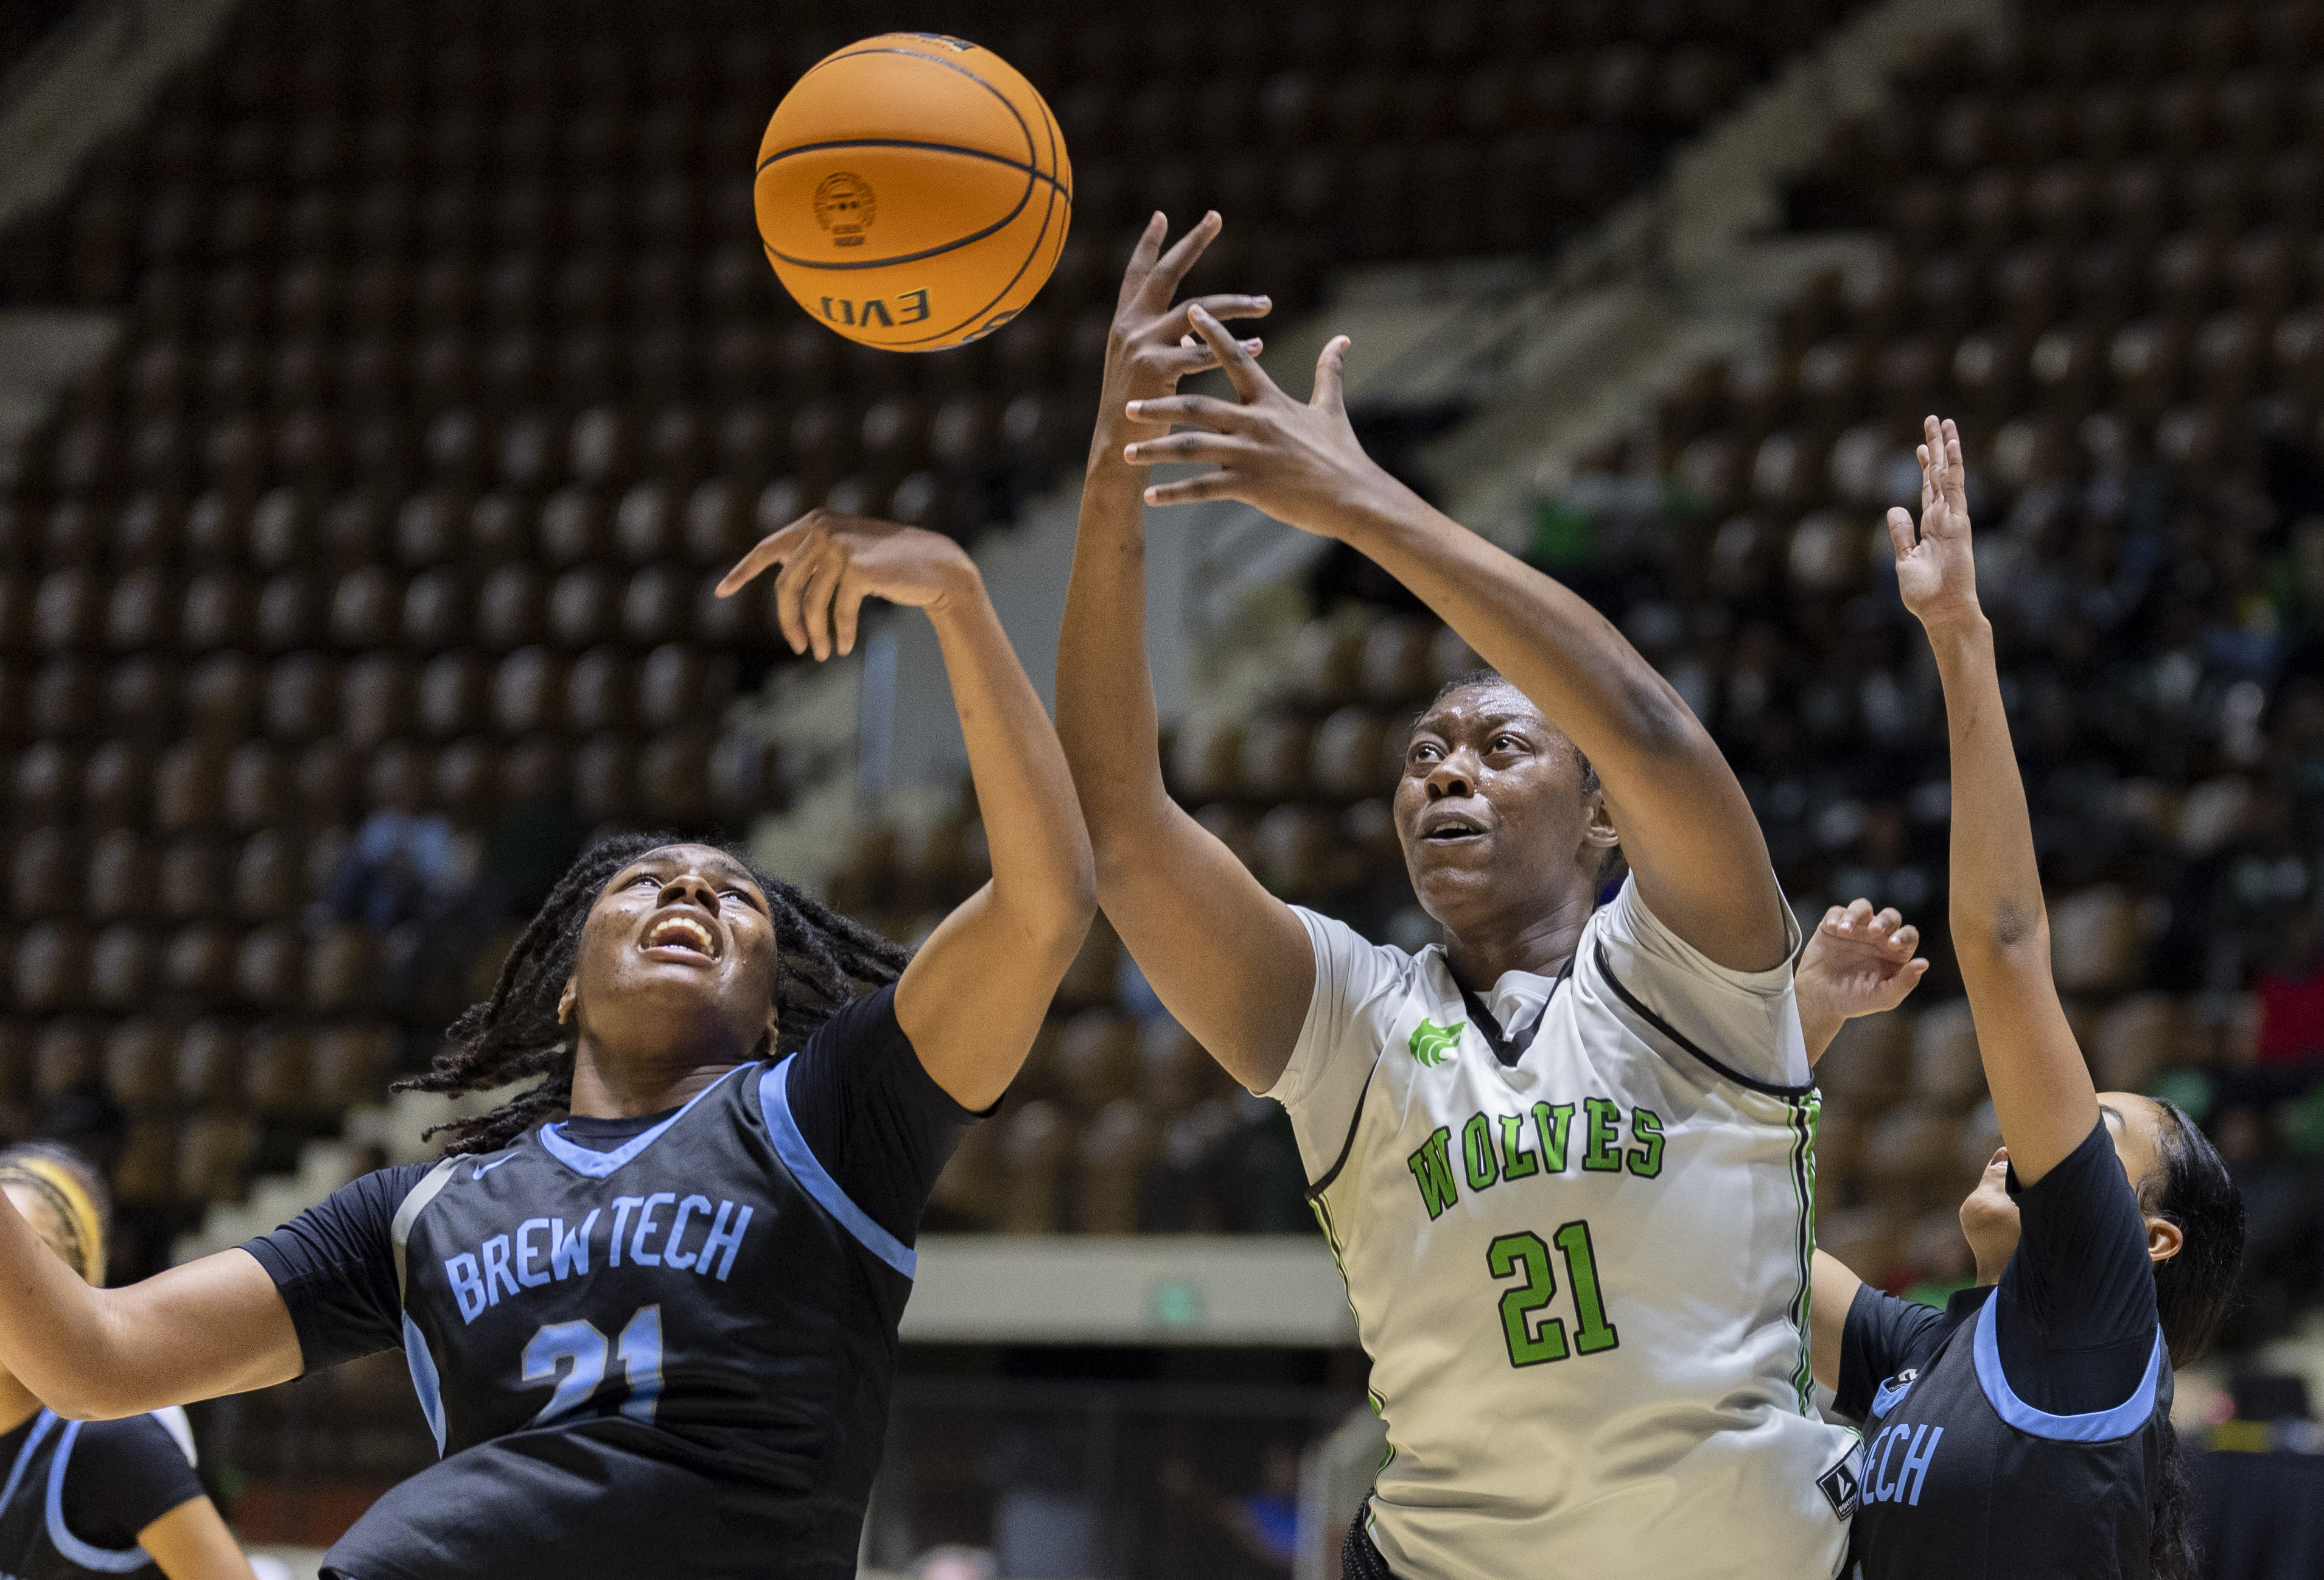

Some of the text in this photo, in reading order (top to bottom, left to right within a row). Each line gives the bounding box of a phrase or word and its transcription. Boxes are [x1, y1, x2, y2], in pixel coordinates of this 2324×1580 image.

[1407, 1097, 1666, 1221] WOLVES
[444, 1192, 754, 1326] BREW TECH
[1486, 1219, 1620, 1368] 21
[521, 1303, 664, 1427] 21
